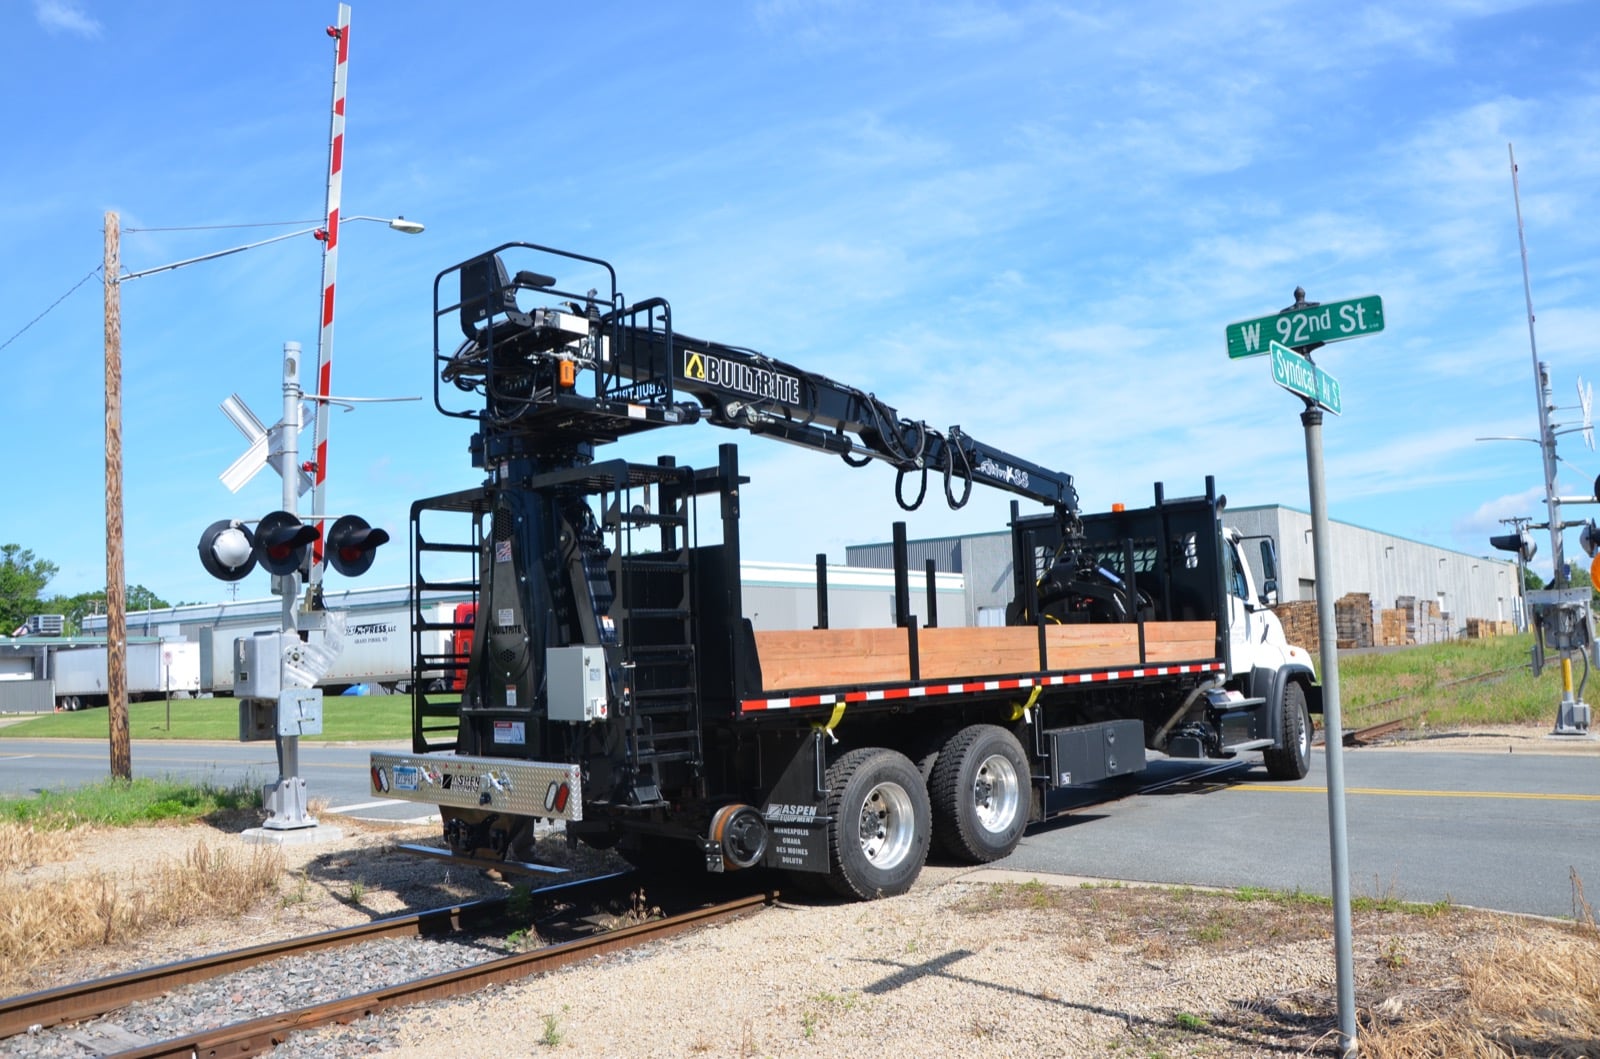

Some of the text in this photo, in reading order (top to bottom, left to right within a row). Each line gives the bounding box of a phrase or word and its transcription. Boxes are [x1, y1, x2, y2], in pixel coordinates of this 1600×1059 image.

[1241, 302, 1368, 352] W 92nd St
[706, 355, 800, 405] BUILTRITE
[1277, 349, 1318, 395] Syndicat
[1332, 381, 1339, 408] S
[782, 804, 817, 816] ASPEN
[774, 827, 809, 836] MINNEAPOLIS
[783, 837, 801, 845] OMAHA
[788, 847, 808, 856] MOINES
[782, 857, 803, 865] DULUTH
